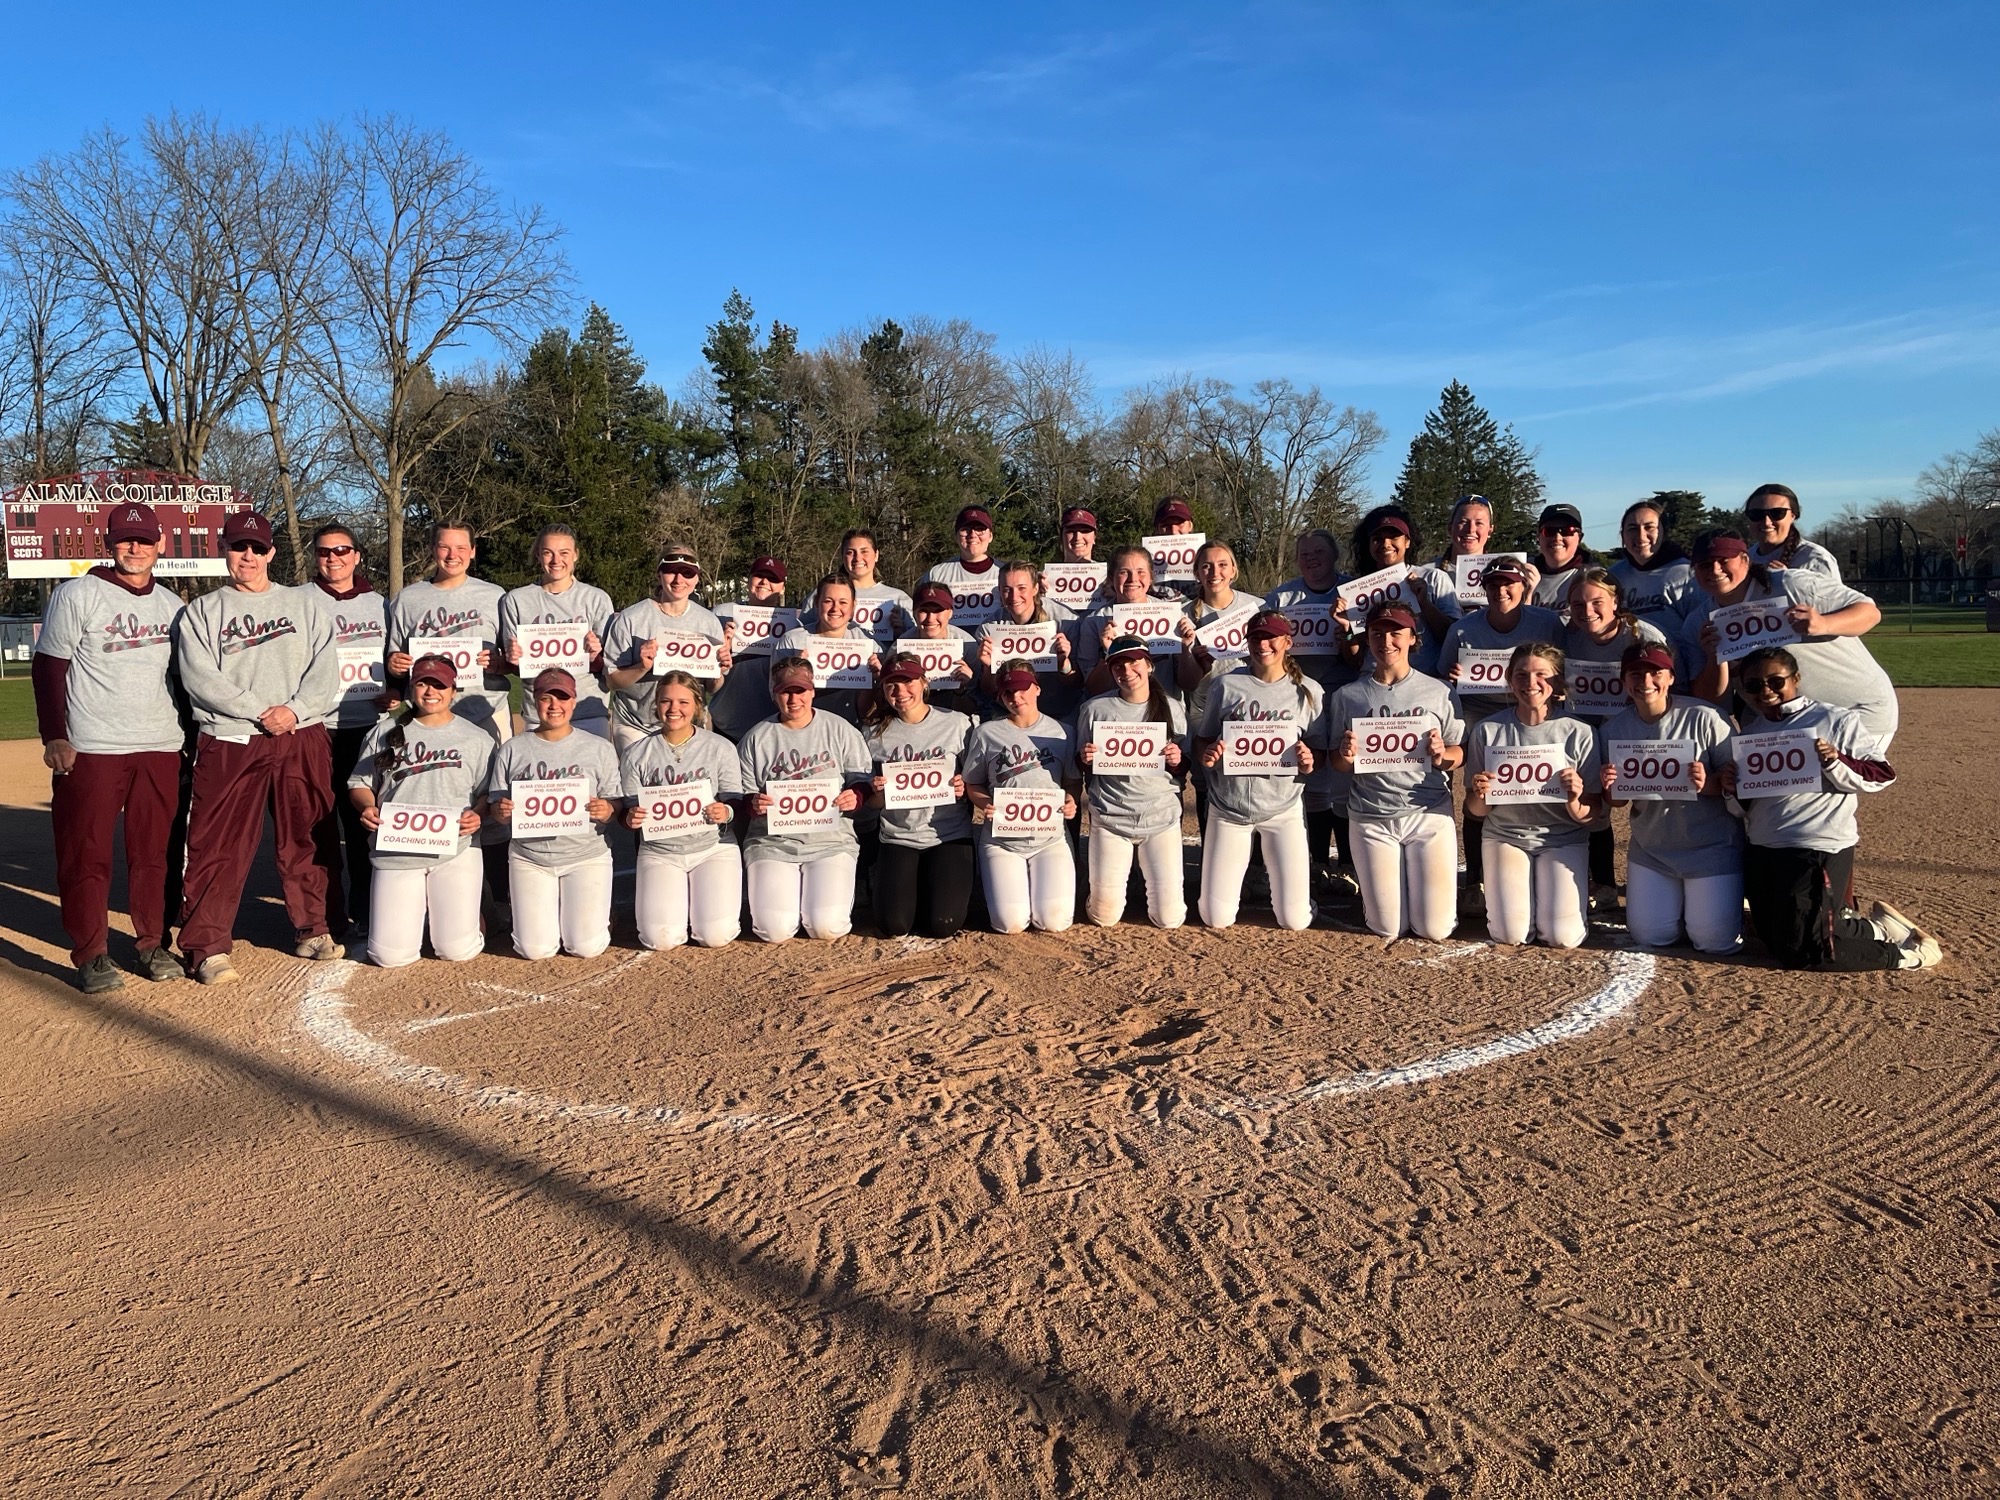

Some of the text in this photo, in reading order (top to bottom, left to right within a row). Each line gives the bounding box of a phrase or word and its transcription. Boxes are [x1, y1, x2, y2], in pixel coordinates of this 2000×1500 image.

[20, 484, 233, 503] ALMA COLLEGE
[127, 510, 142, 521] A
[244, 518, 258, 529] A
[11, 536, 43, 546] GUEST
[14, 548, 42, 558] SCOTS
[1154, 549, 1196, 565] 900
[1055, 577, 1096, 592] 900
[954, 593, 994, 609] 900
[1356, 582, 1401, 612] 900
[336, 615, 381, 634] lma
[418, 607, 481, 637] Alma
[856, 608, 883, 623] 00
[103, 613, 170, 642] Alma
[222, 614, 294, 644] Alma
[742, 621, 785, 638] 900
[1124, 618, 1170, 636] 900
[1290, 618, 1329, 637] 900
[1726, 615, 1782, 642] 900
[530, 639, 577, 658] 900
[666, 642, 711, 659] 900
[1001, 637, 1046, 654] 900
[1722, 635, 1793, 656] COACHING WINS
[817, 653, 861, 670] 900
[923, 655, 952, 671] 00
[341, 663, 370, 682] 00
[1470, 663, 1503, 682] 90
[1575, 676, 1623, 696] 900
[1230, 700, 1294, 721] Alma
[1105, 738, 1154, 757] 900
[1235, 737, 1285, 756] 900
[1366, 733, 1418, 753] 900
[395, 741, 462, 771] Alma
[888, 744, 946, 763] Alma
[995, 744, 1054, 773] Alma
[1747, 748, 1805, 775] 900
[513, 761, 583, 780] Alma
[771, 749, 831, 780] Alma
[1498, 763, 1553, 784] 900
[1623, 758, 1680, 779] 900
[896, 771, 942, 790] 900
[1743, 776, 1814, 789] COACHING WINS
[525, 796, 577, 817] 900
[652, 798, 701, 821] 900
[779, 795, 828, 815] 900
[1005, 804, 1052, 822] 900
[392, 812, 446, 833] 900
[648, 824, 688, 832] COACHING
[383, 836, 426, 844] COACHING
